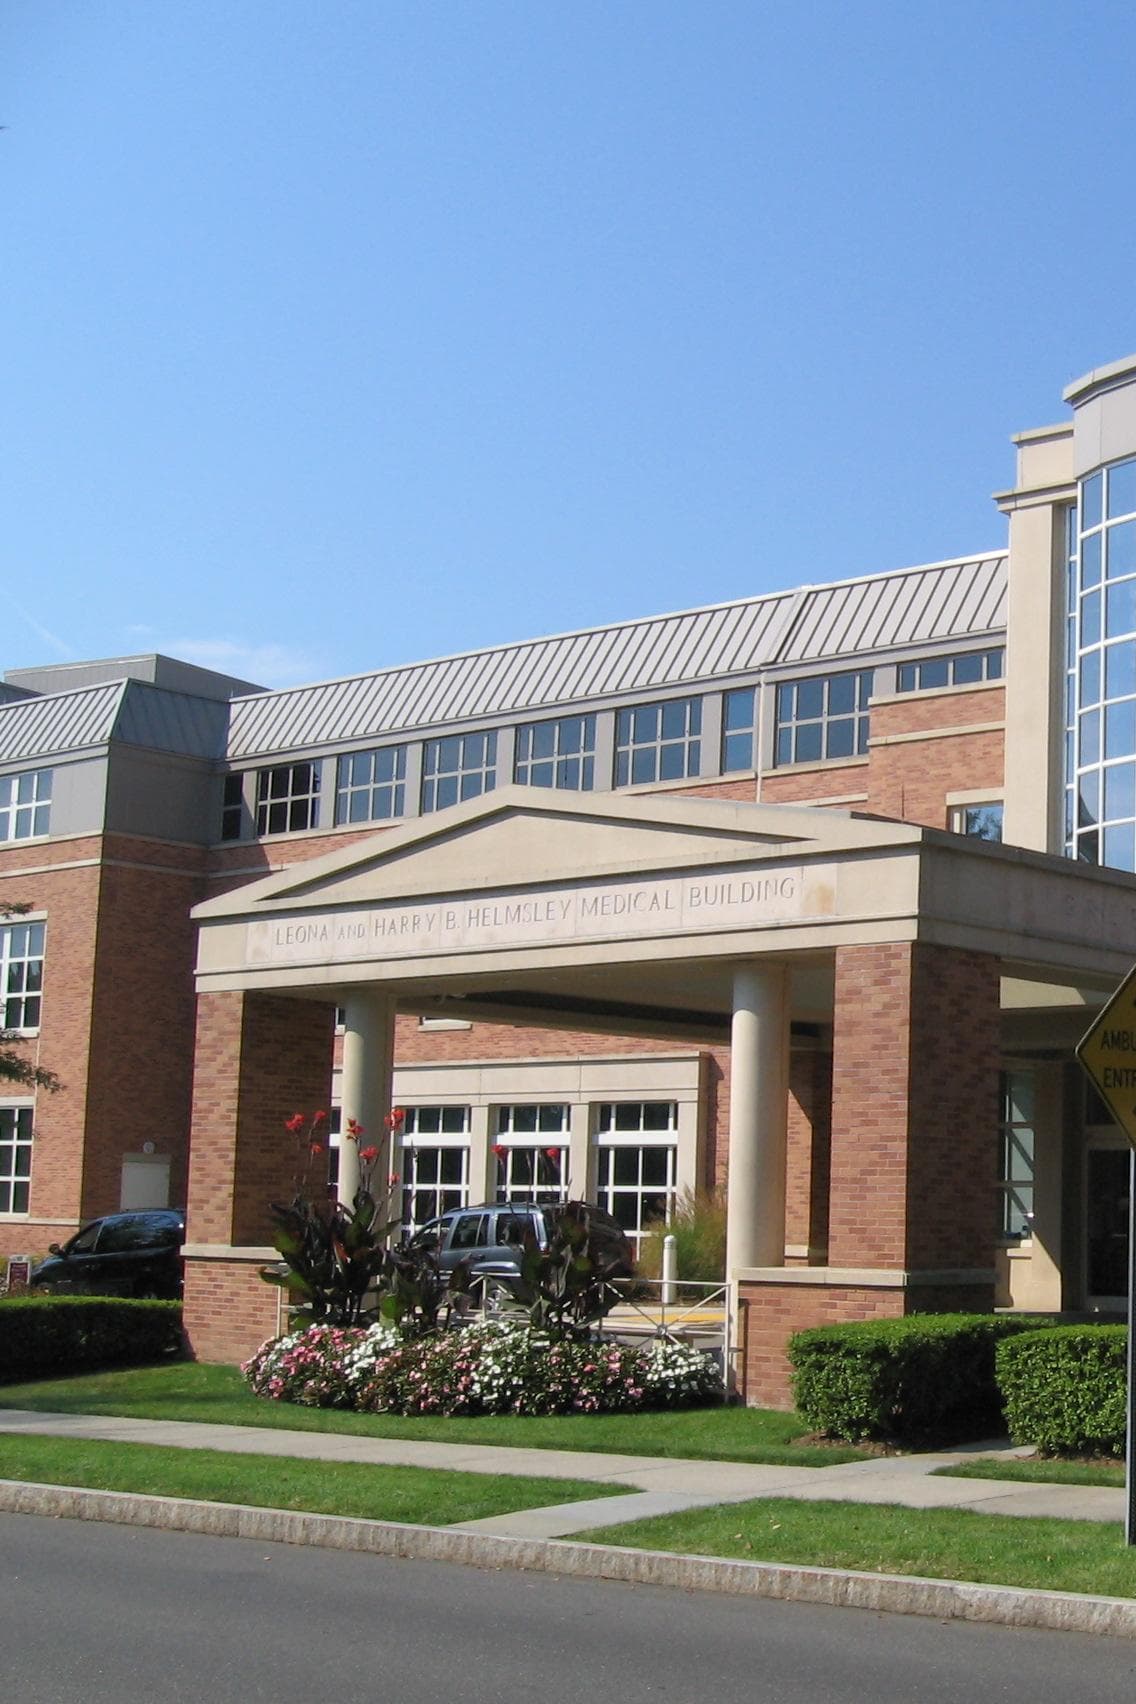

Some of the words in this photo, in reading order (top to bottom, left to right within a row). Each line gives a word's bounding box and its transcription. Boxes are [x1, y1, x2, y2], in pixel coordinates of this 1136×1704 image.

[275, 924, 329, 946] LEONA
[337, 923, 366, 941] AND
[374, 913, 436, 937] HARRY
[445, 910, 461, 930] B.
[467, 899, 572, 929] HELMSLEY
[580, 889, 676, 918] MEDICAL
[688, 877, 795, 908] BUILDING
